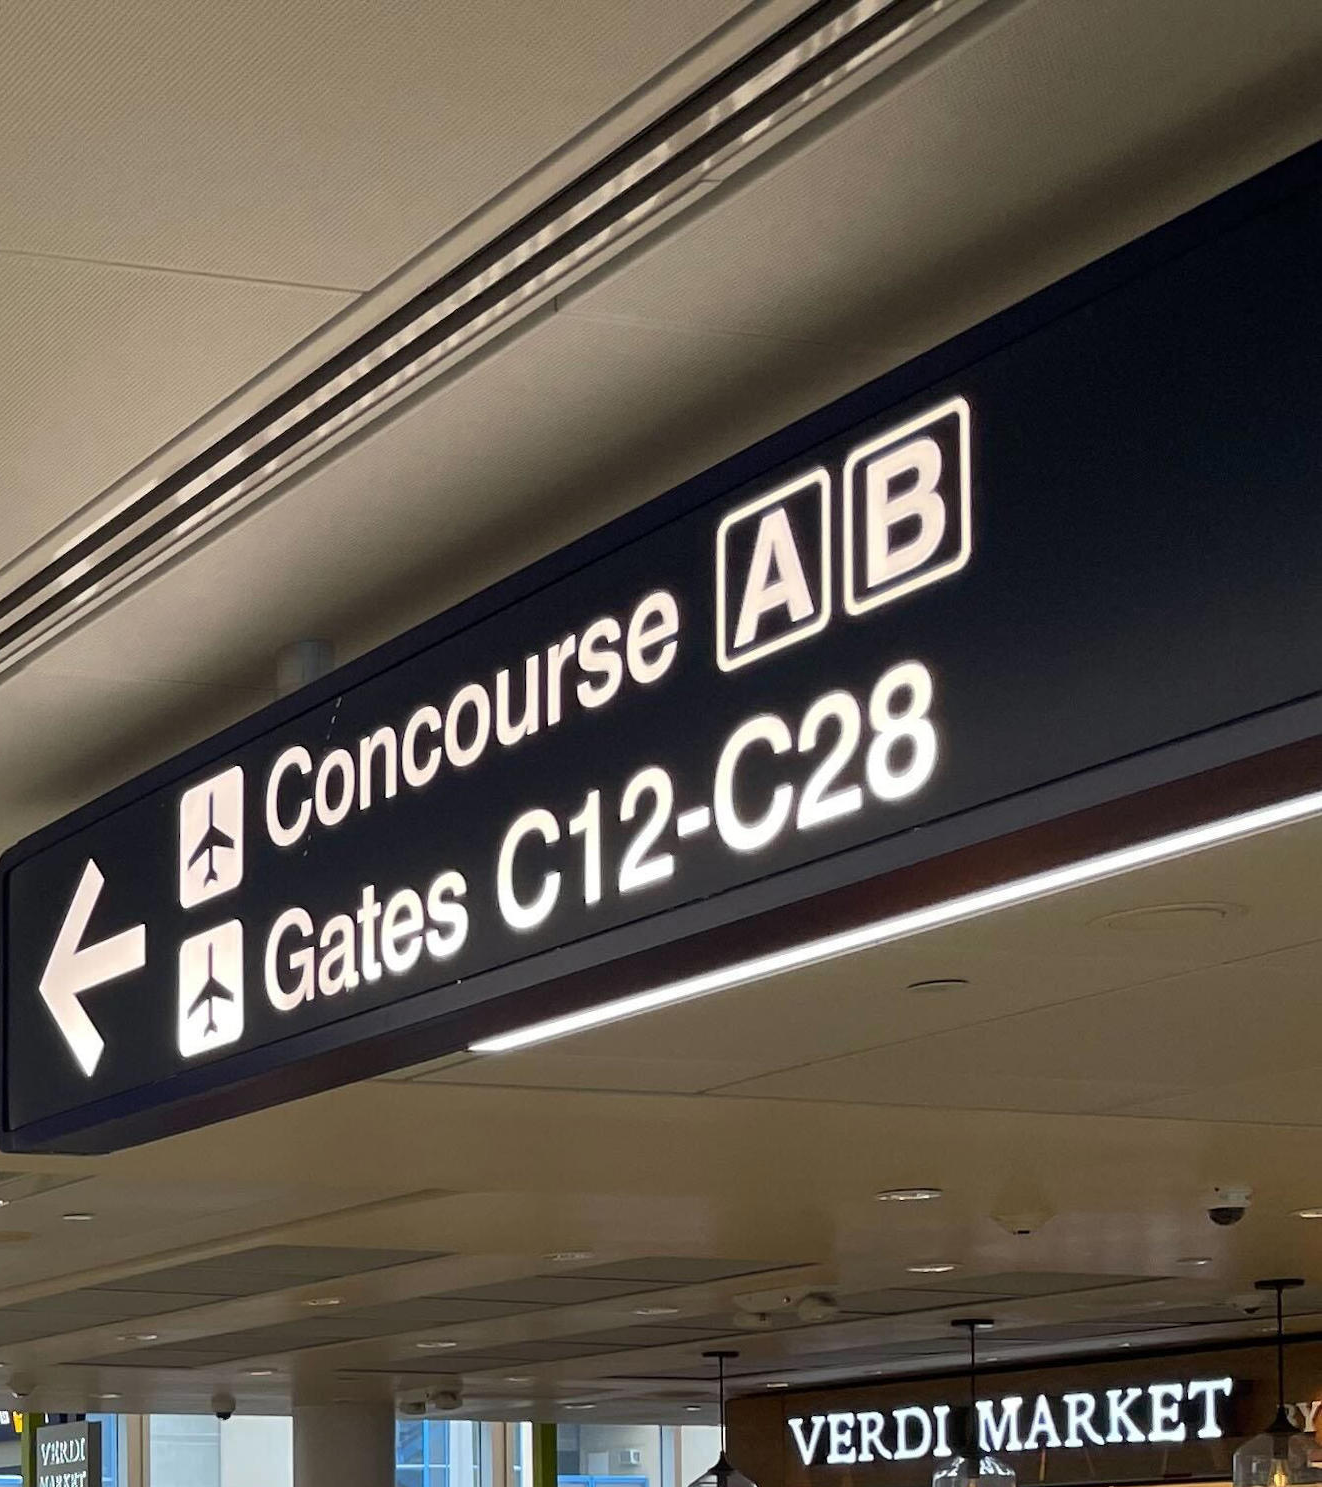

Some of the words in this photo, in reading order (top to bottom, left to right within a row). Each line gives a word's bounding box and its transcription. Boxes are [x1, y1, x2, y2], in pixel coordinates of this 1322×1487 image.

[264, 590, 680, 849] Concourse
[730, 504, 817, 653] A
[860, 435, 946, 591] B
[264, 870, 469, 1012] Gates
[495, 659, 938, 932] C12-C28
[787, 1404, 954, 1473] VERDI
[975, 1377, 1233, 1453] MARKET
